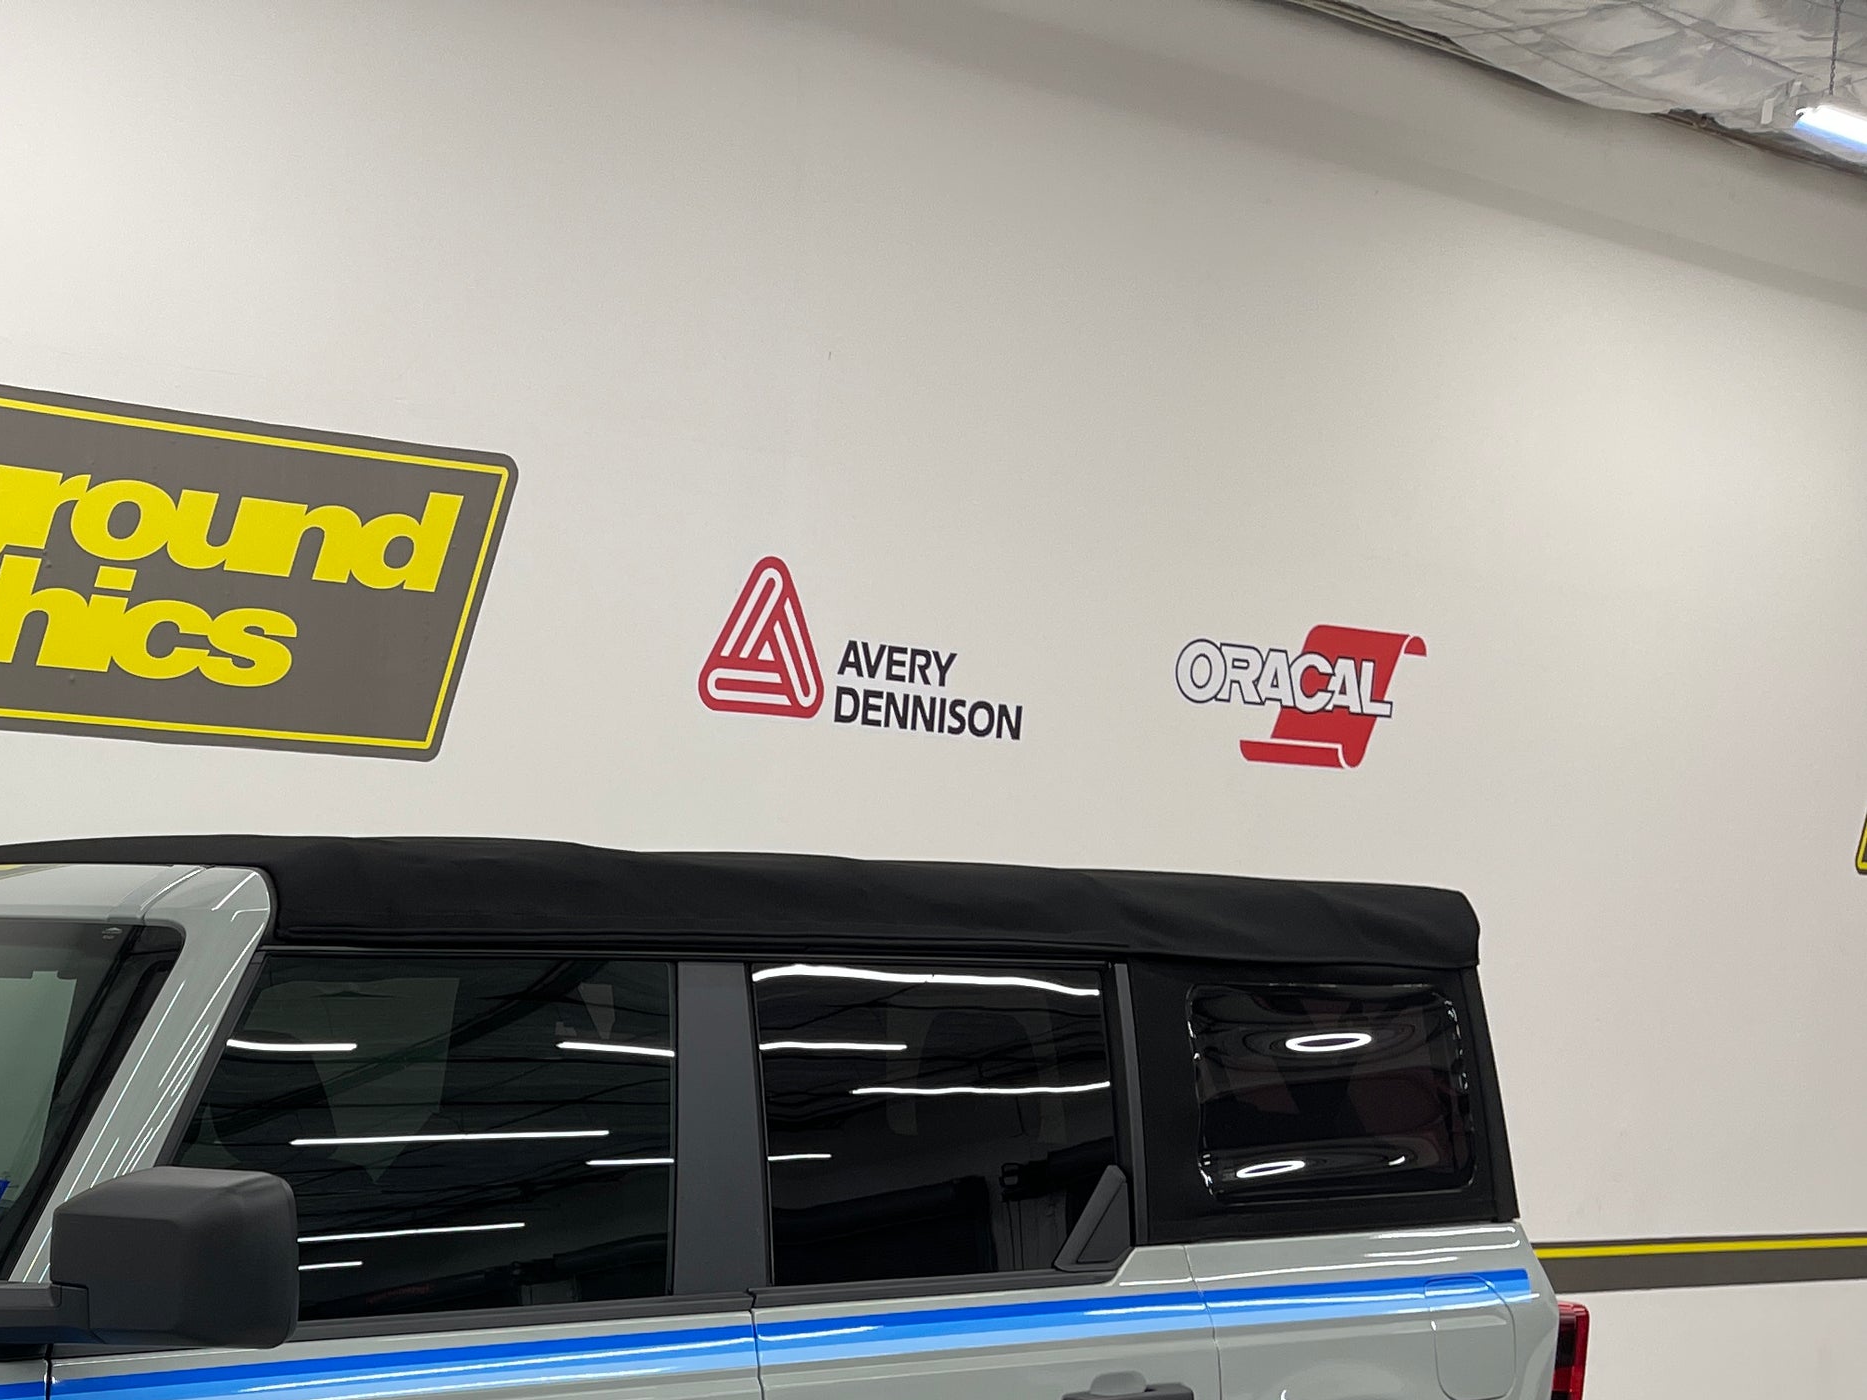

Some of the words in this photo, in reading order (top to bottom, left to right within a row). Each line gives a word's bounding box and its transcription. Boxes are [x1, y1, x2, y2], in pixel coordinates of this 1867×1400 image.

[837, 639, 958, 688] AVERY
[1175, 637, 1393, 718] ORACAL
[833, 686, 1023, 740] DENNISON
